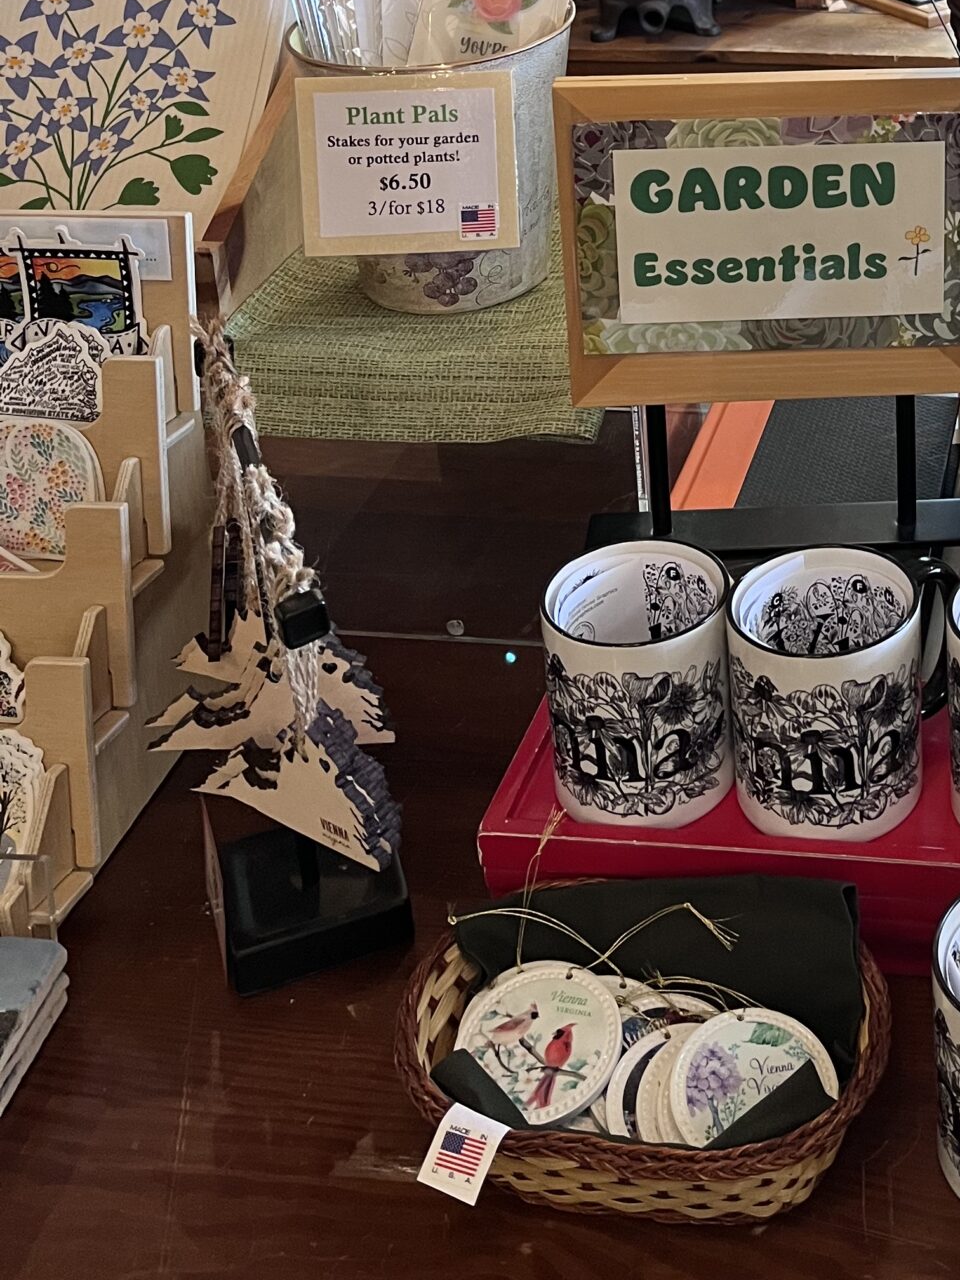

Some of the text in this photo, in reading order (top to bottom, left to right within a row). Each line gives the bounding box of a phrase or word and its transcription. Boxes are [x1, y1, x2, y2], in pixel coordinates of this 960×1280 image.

[345, 104, 459, 126] Plant Pals
[327, 131, 480, 152] Stakes for your garden
[348, 150, 461, 168] or potted plants!
[379, 172, 432, 192] $6.50
[629, 161, 897, 215] GARDEN
[367, 198, 446, 217] 3/for $18
[633, 242, 889, 288] Essentials
[549, 989, 589, 1007] Vienna
[556, 1005, 593, 1018] VIRGINIA
[749, 1055, 795, 1076] Vienna
[449, 1124, 472, 1136] MADE
